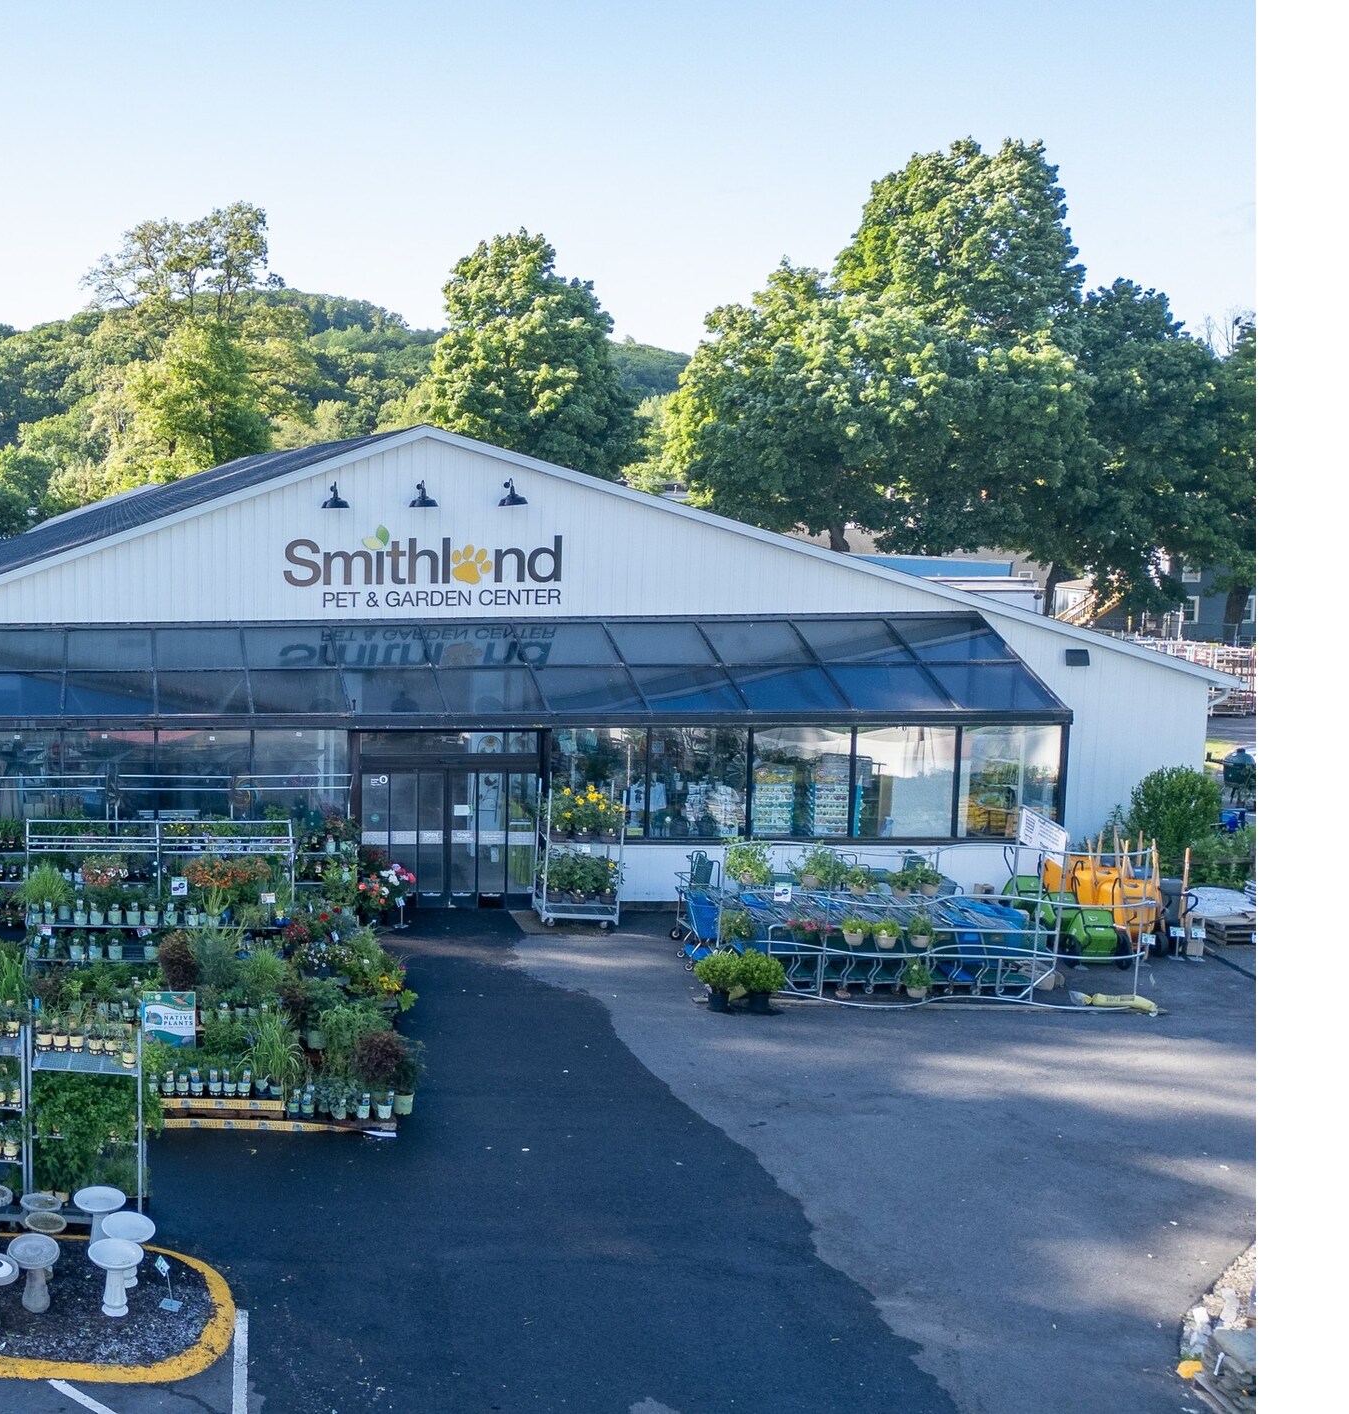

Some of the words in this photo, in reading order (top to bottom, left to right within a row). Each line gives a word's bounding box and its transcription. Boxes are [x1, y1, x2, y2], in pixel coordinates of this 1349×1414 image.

[283, 528, 563, 587] Smithlnd
[322, 591, 361, 608] PET
[366, 591, 380, 608] &
[385, 590, 472, 607] GARDEN
[478, 588, 562, 606] CENTER
